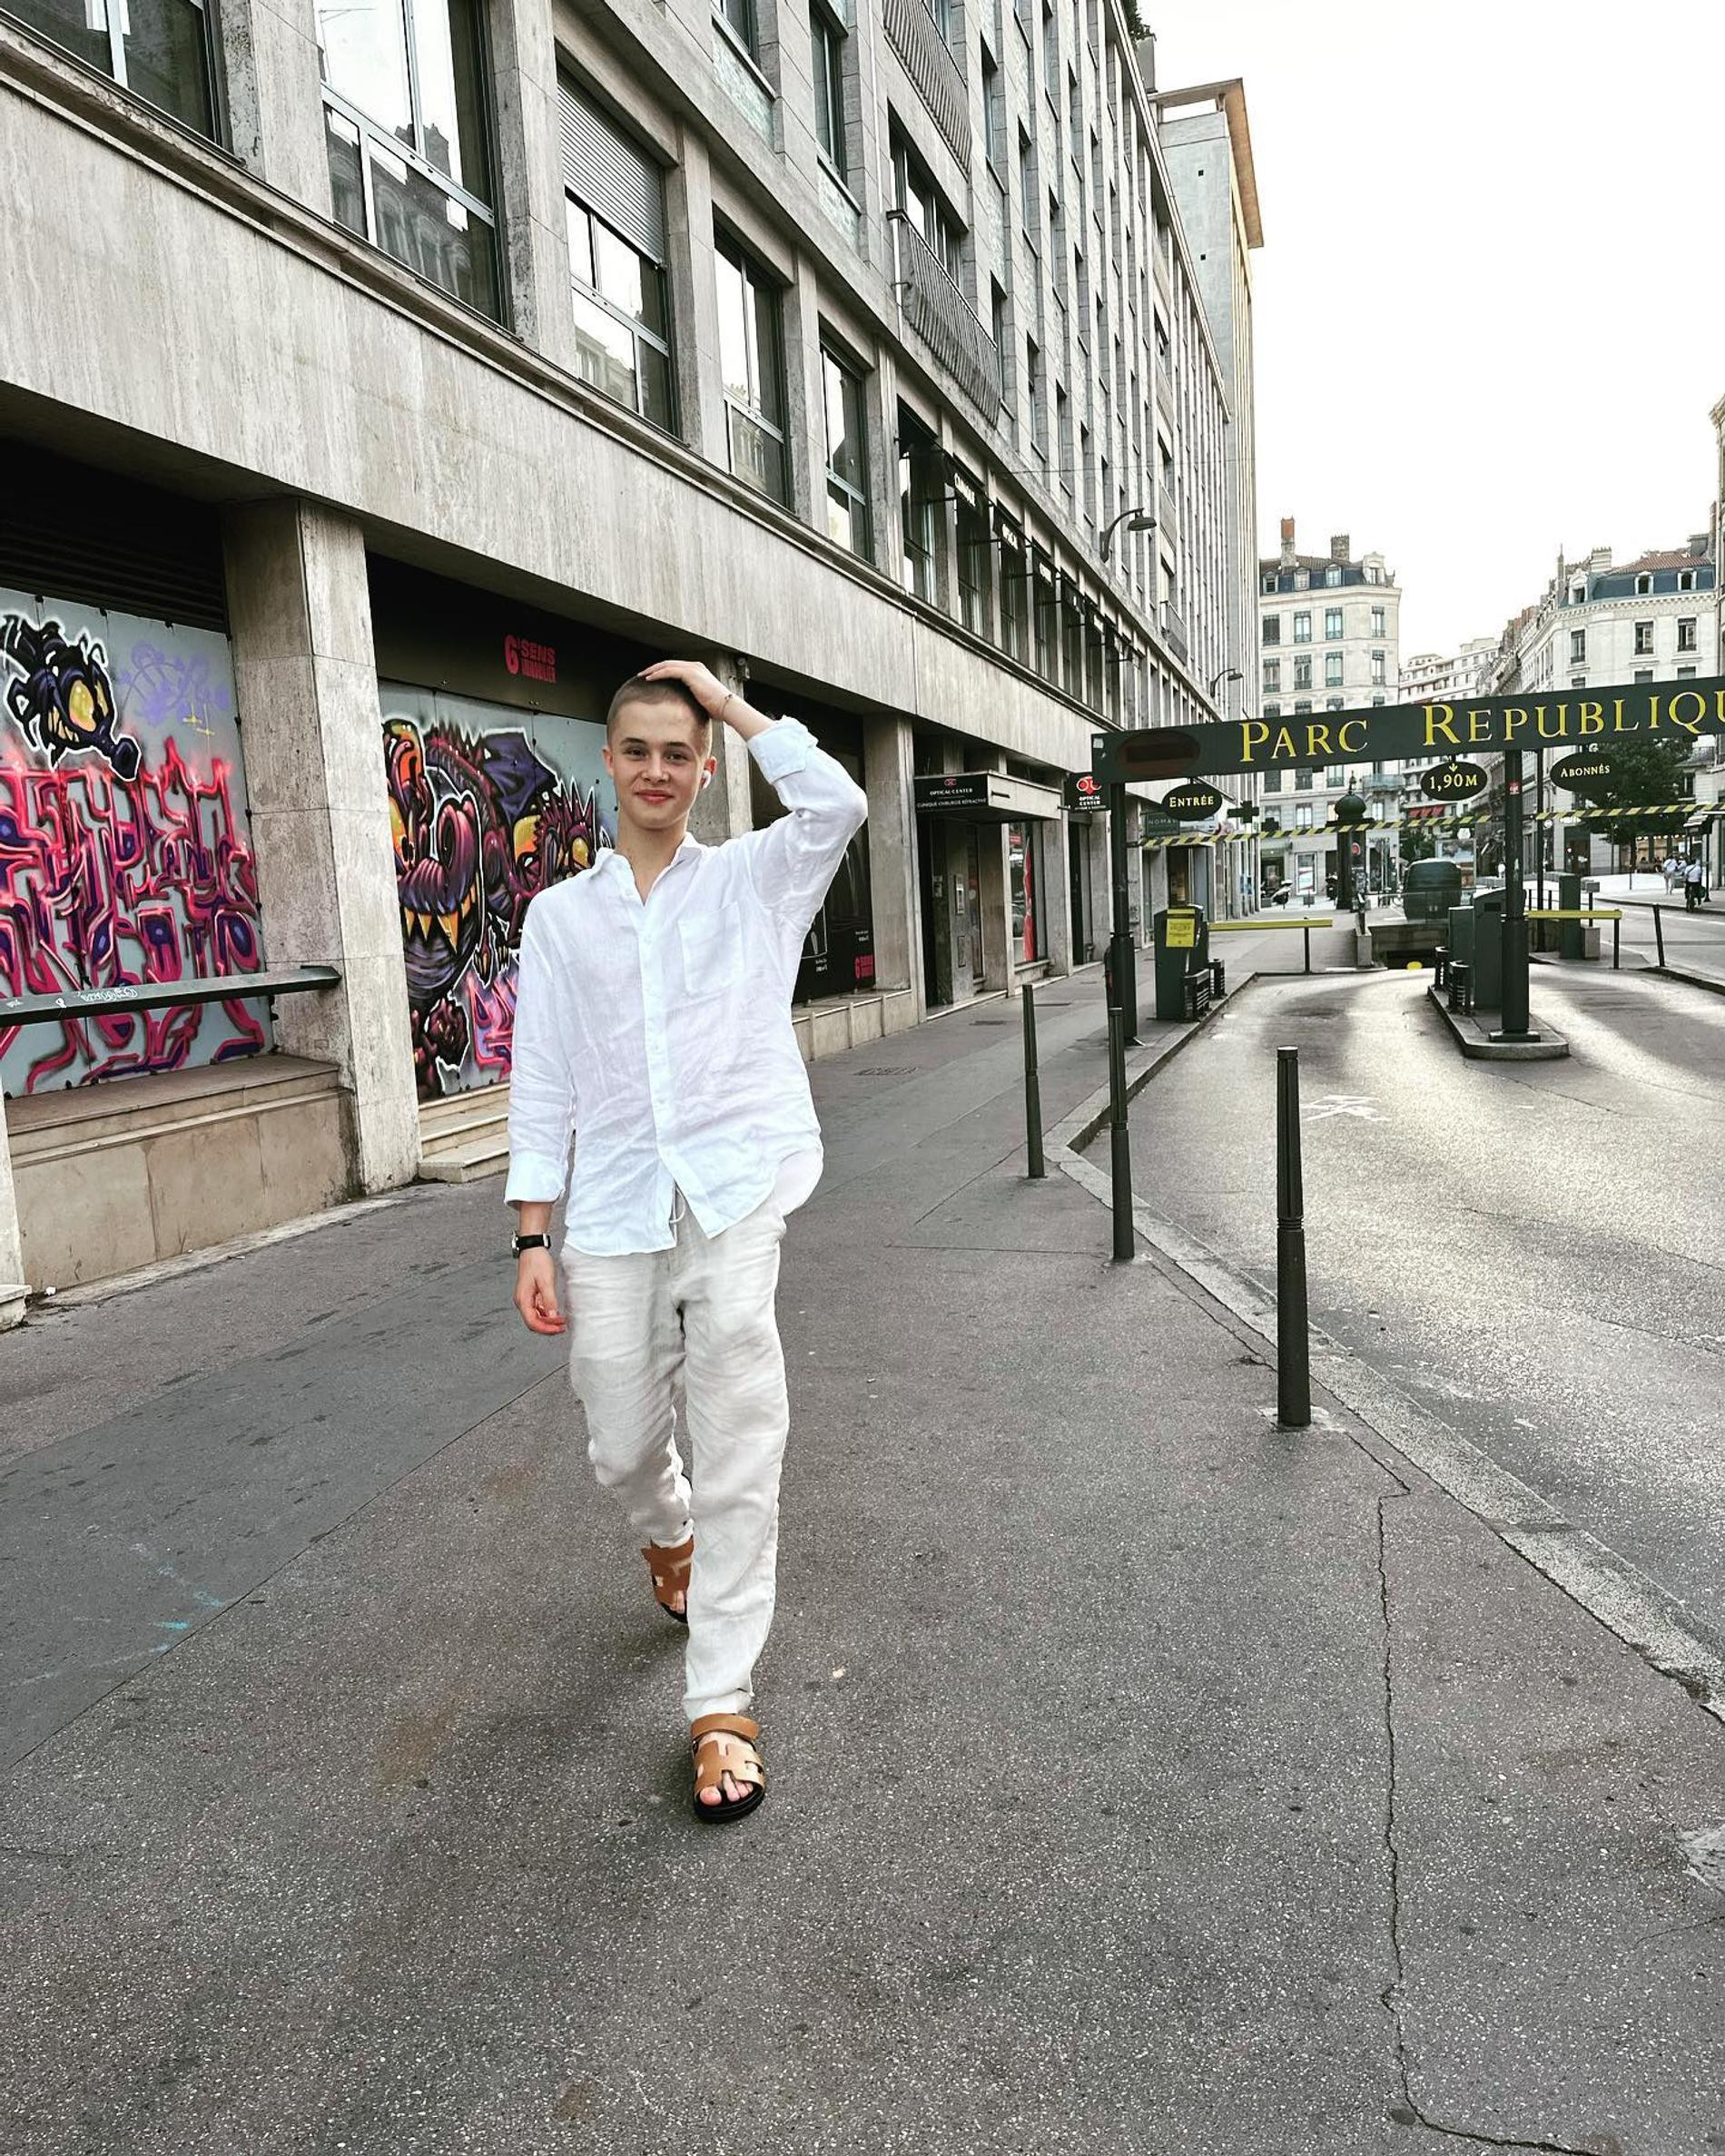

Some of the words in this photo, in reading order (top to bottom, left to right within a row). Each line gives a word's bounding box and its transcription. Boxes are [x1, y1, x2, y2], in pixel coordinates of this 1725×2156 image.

[521, 639, 556, 665] SENS
[1239, 720, 1368, 762] PARC
[1561, 763, 1611, 778] ABONNÉS
[1169, 794, 1215, 808] ENTRÉE
